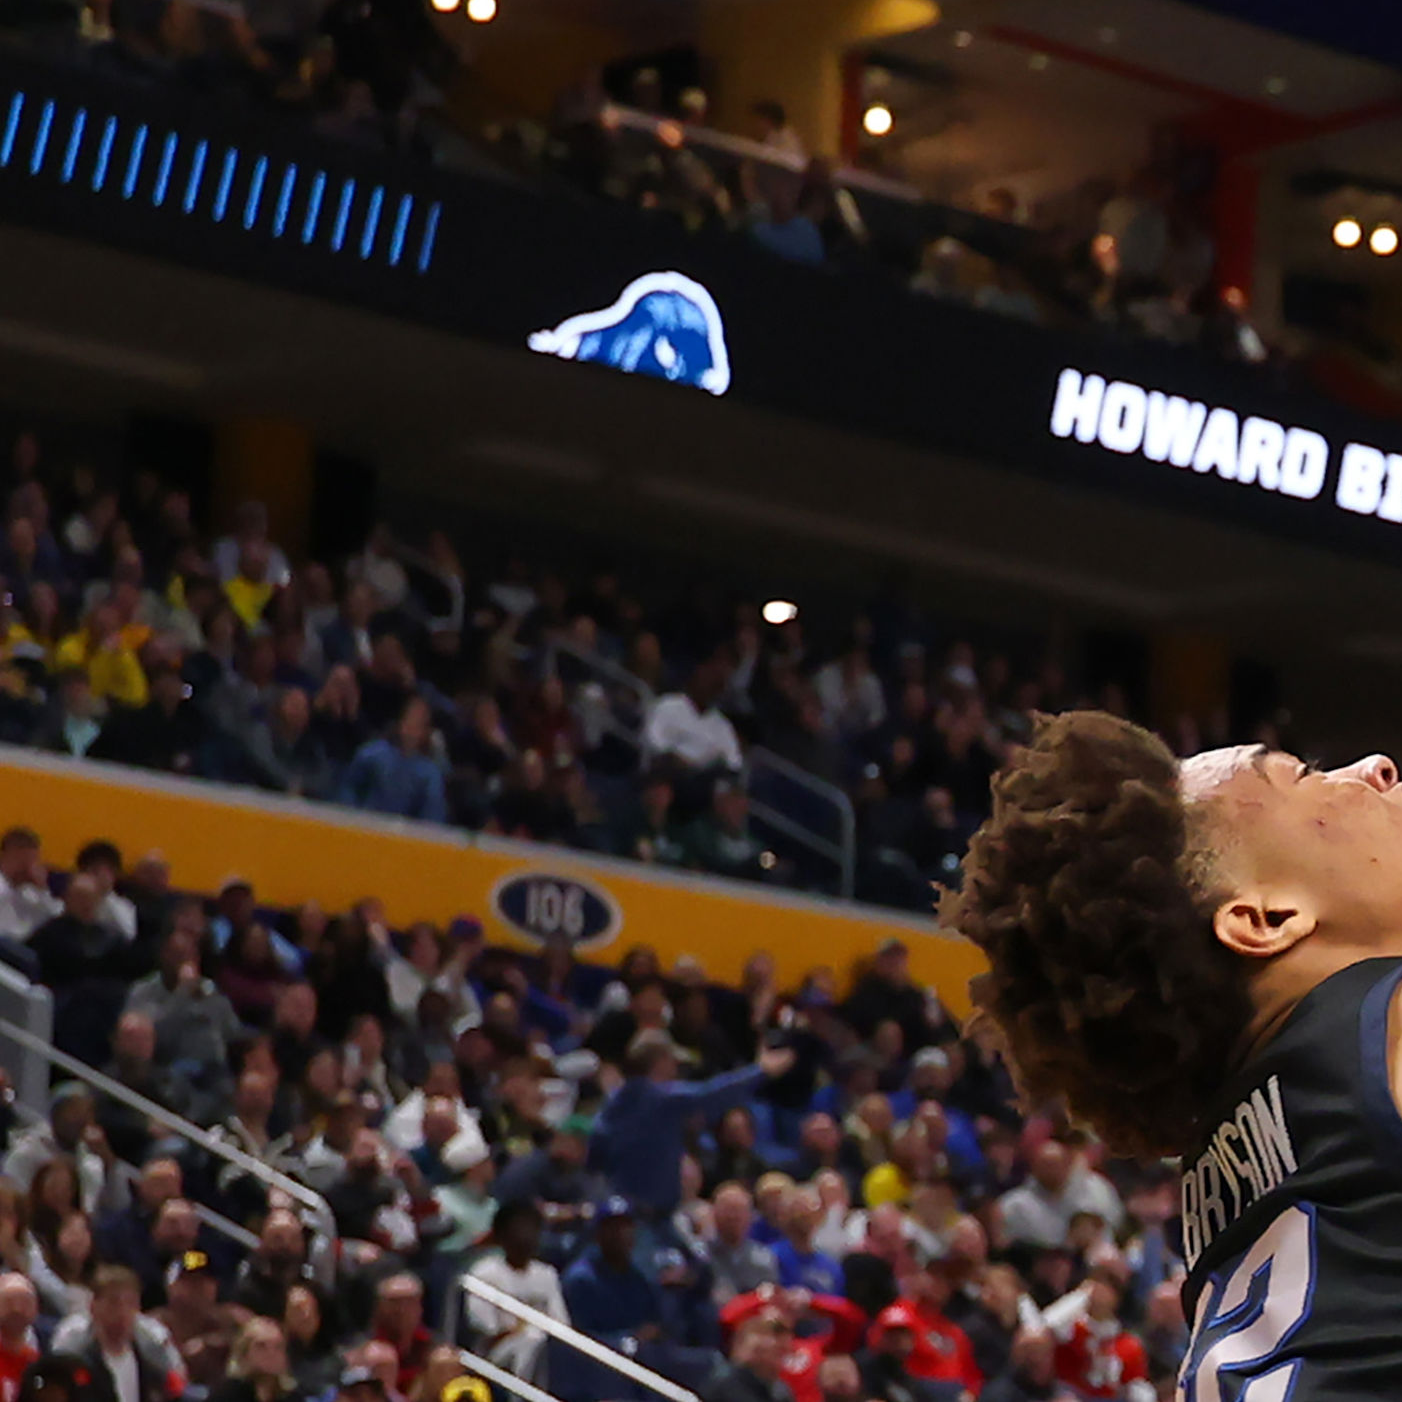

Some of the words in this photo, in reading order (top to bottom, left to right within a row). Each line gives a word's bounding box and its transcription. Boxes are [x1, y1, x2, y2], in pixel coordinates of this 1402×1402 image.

[1050, 367, 1330, 499] HOWARD
[525, 881, 586, 937] 106
[1182, 1073, 1299, 1274] BRYSON
